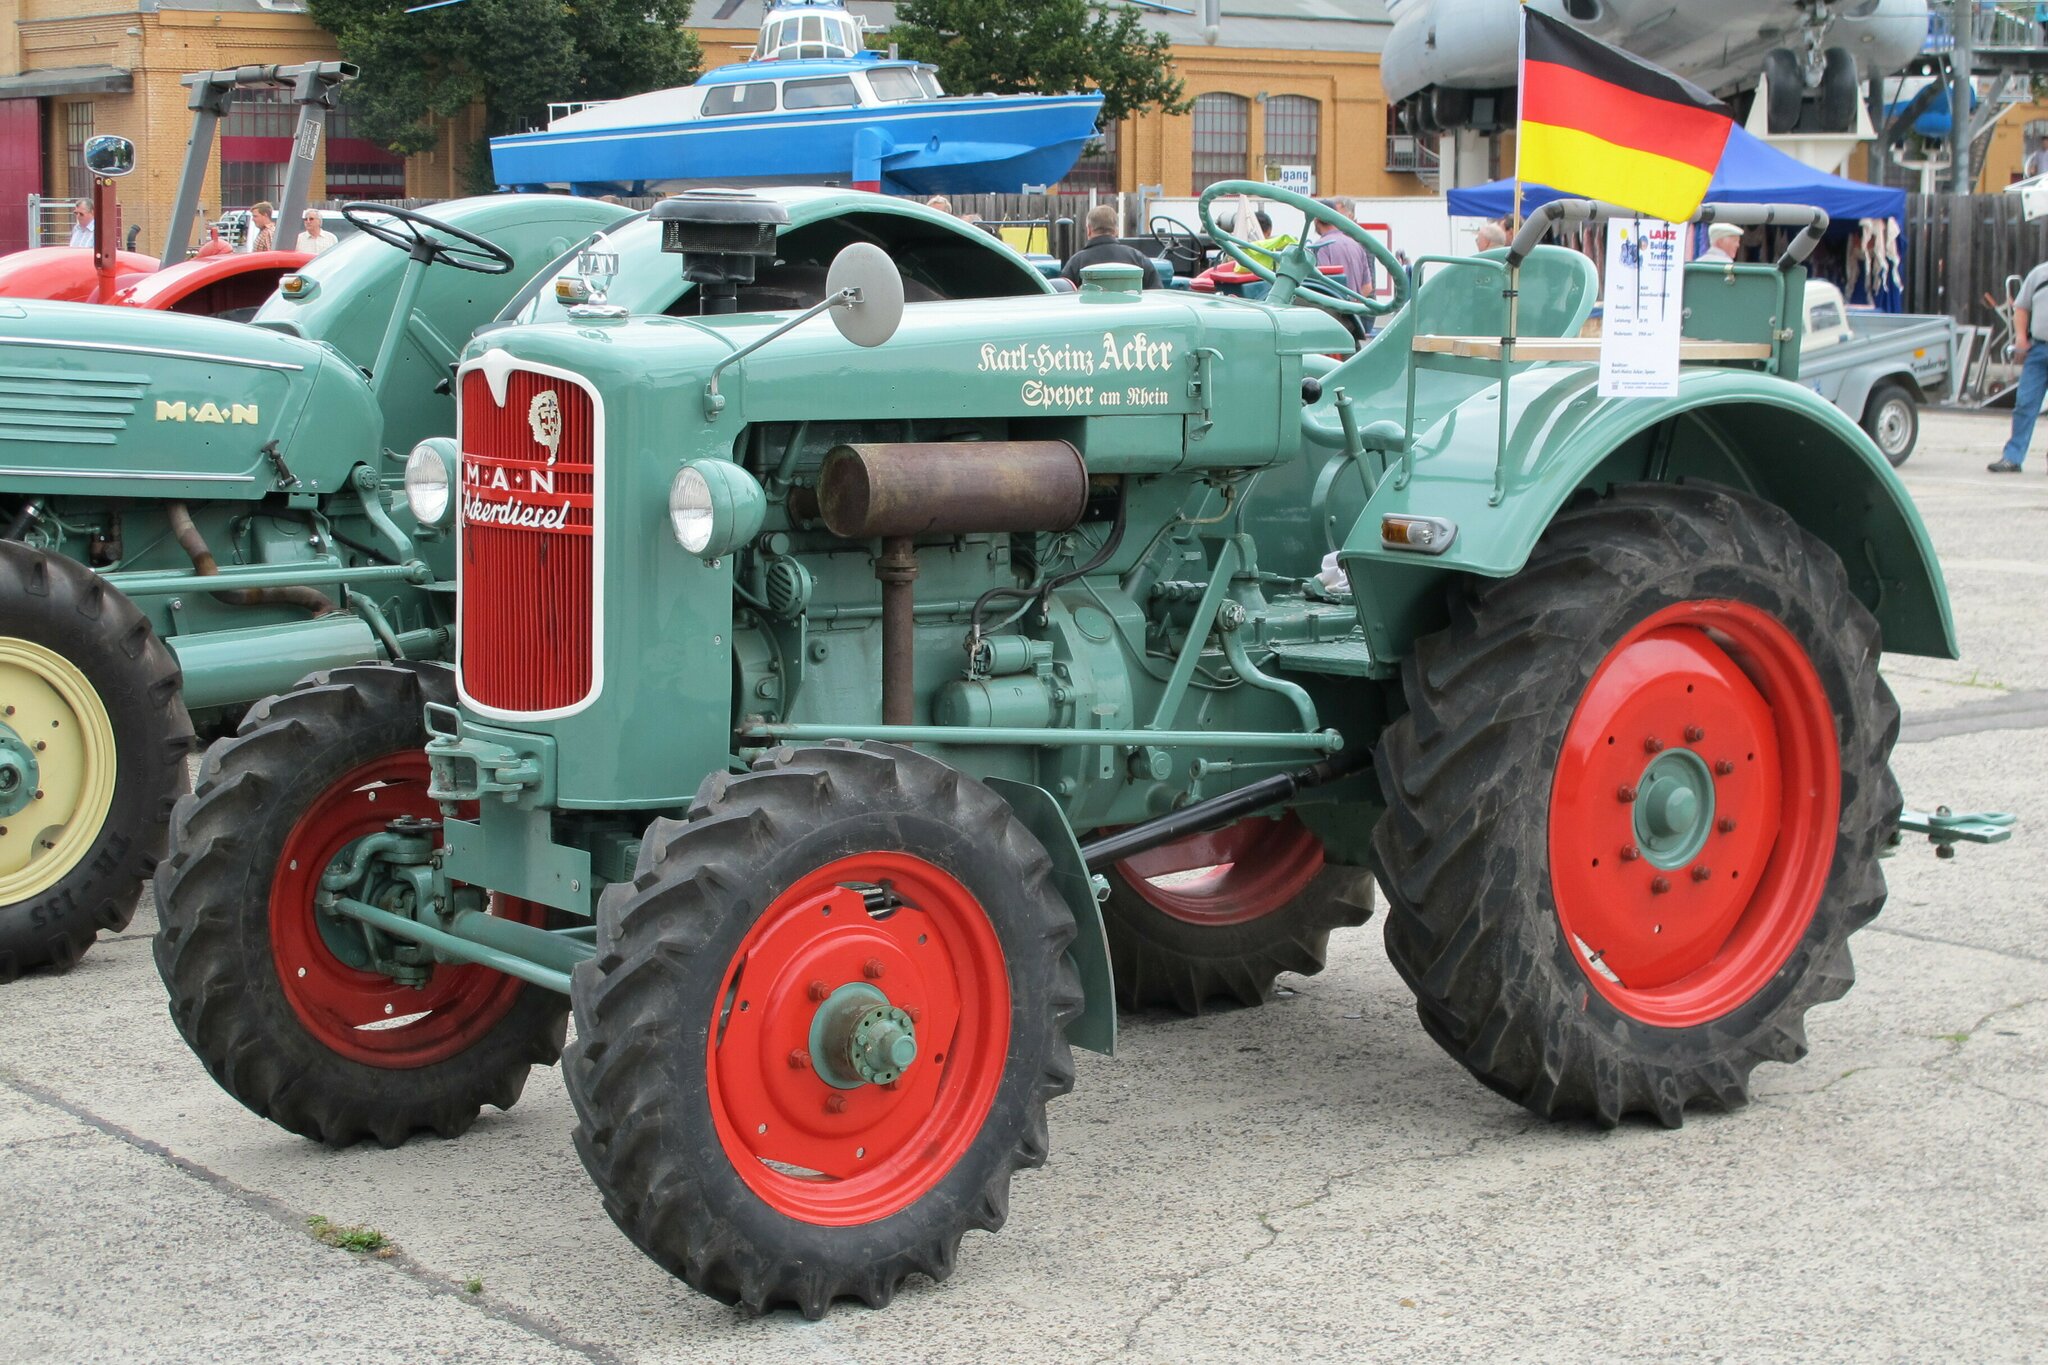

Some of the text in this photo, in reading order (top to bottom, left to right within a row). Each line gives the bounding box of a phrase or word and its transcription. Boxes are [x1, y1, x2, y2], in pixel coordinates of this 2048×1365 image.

[1277, 170, 1309, 183] gang
[1649, 230, 1676, 240] LANZ
[977, 331, 1173, 376] Karl-Heinz Acker
[1021, 379, 1169, 411] Speyer am Rhein
[462, 489, 571, 529] Ackerdiesel
